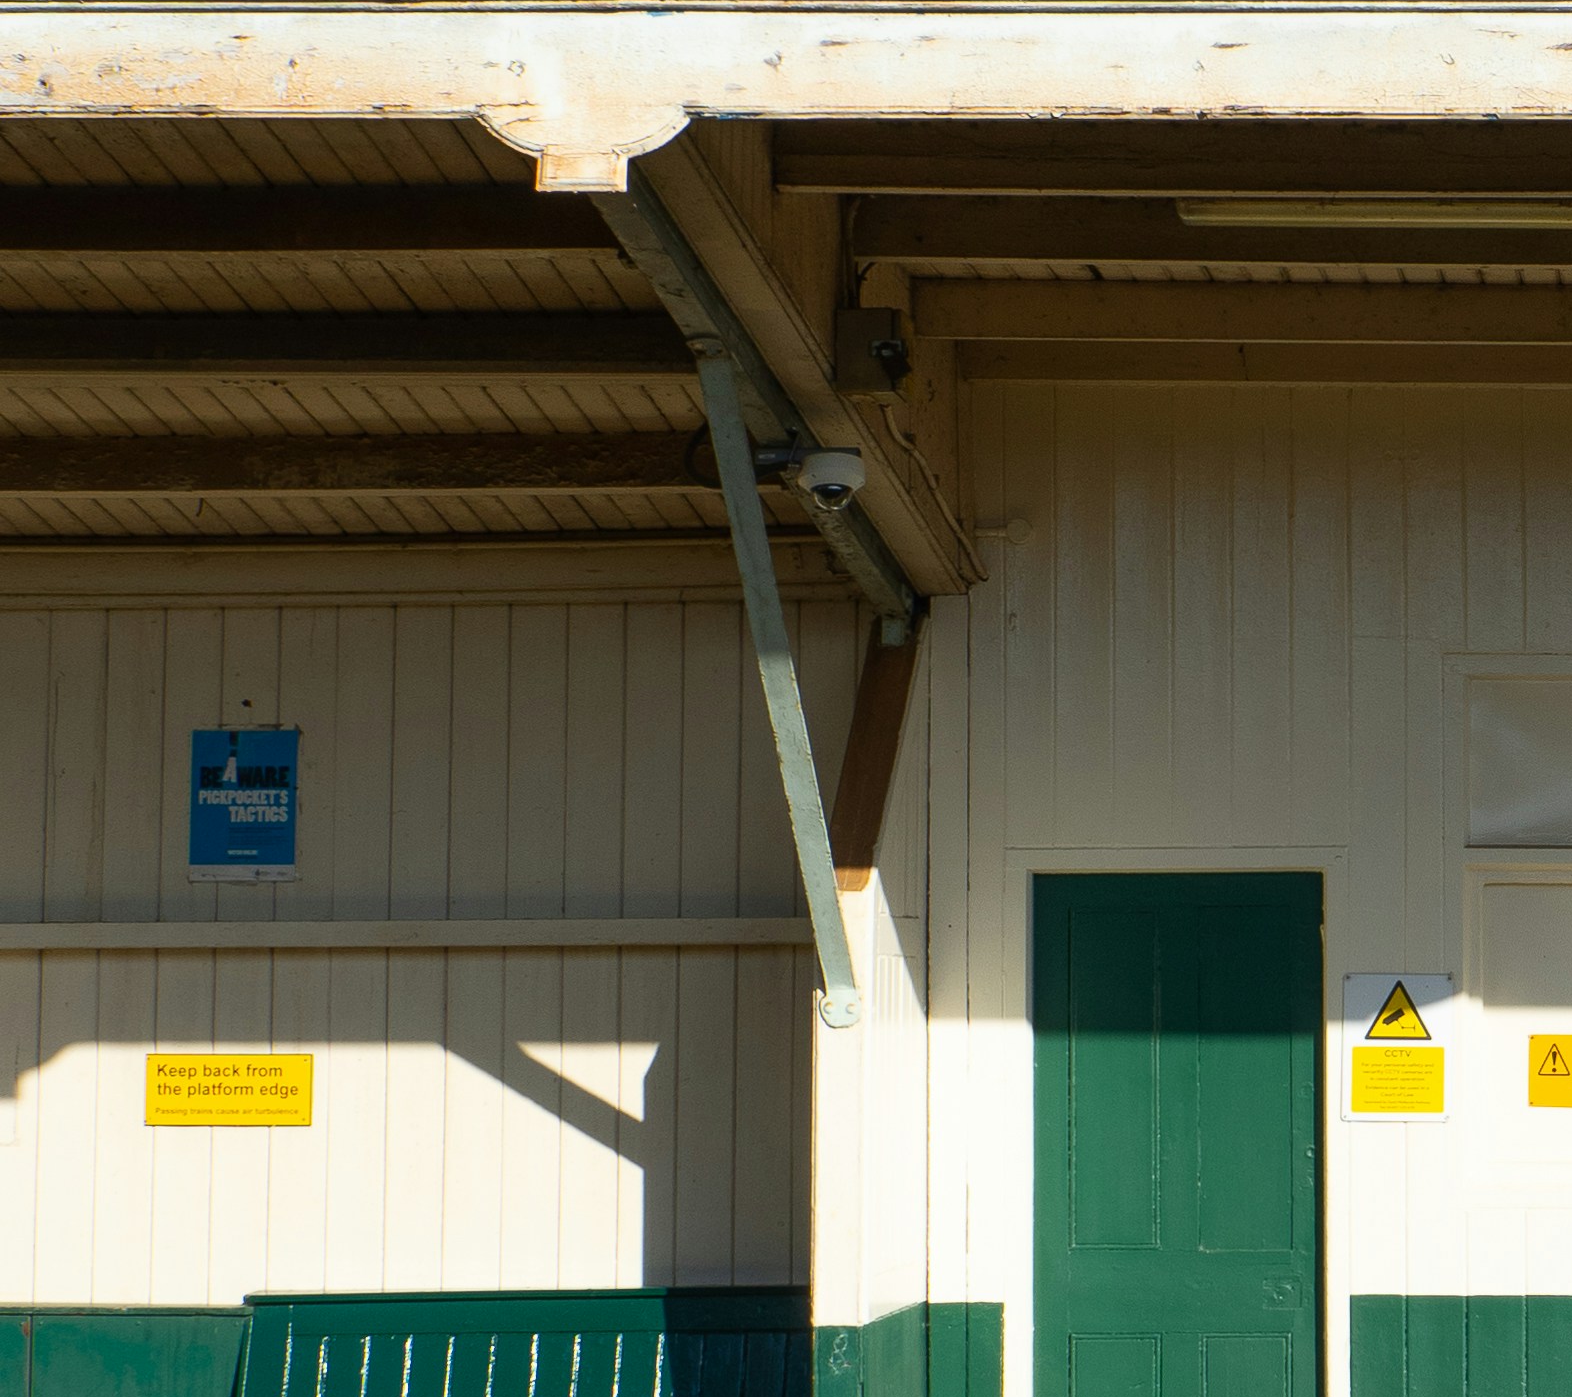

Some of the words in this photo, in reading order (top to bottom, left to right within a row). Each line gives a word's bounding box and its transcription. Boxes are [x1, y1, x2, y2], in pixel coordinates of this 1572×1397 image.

[228, 806, 289, 823] TACTICS
[1384, 1049, 1412, 1058] CCTV
[157, 1064, 197, 1080] Keep
[203, 1064, 240, 1077] back
[246, 1064, 283, 1077] from
[157, 1083, 182, 1096] the
[187, 1083, 254, 1098] platform
[259, 1083, 299, 1099] edge
[155, 1107, 188, 1116] Passing
[190, 1107, 213, 1115] trains
[255, 1107, 299, 1115] turbulence
